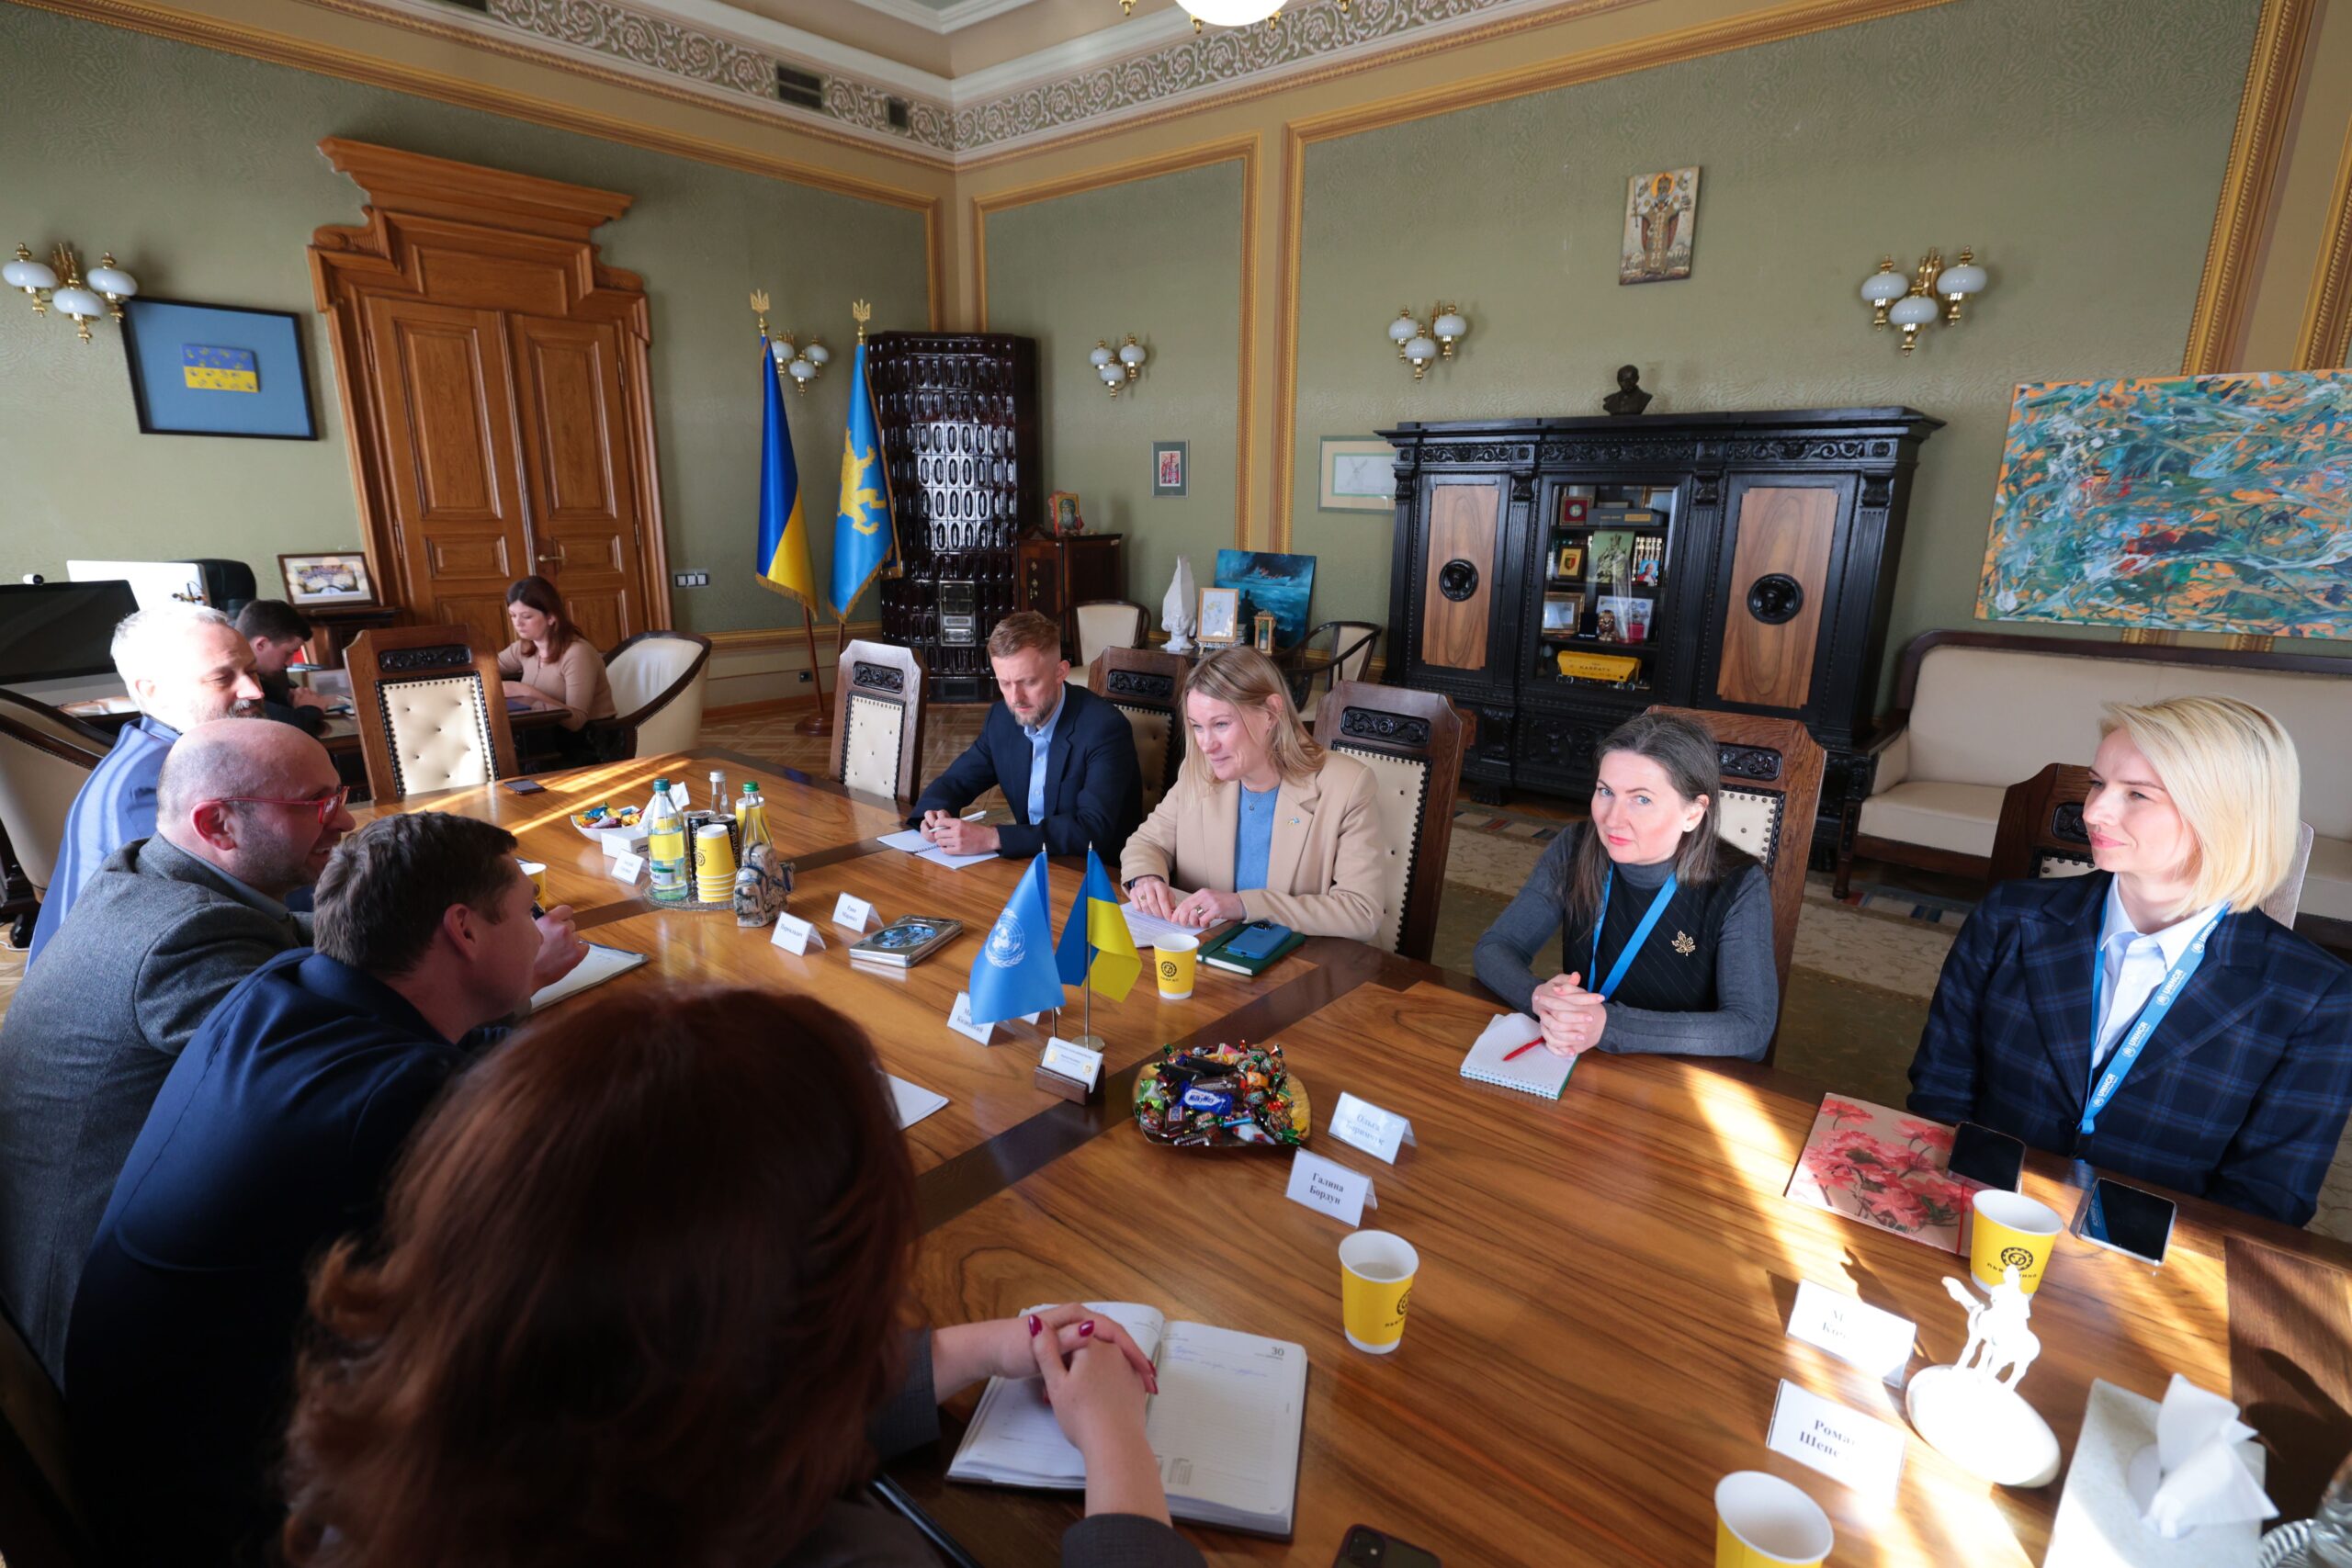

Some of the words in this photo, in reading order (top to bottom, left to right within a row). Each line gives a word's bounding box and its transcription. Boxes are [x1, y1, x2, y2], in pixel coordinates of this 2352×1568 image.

[2198, 919, 2219, 942] UNHCR
[2162, 969, 2184, 995] UNHCR
[2129, 1021, 2149, 1047] UNHCR
[2097, 1072, 2116, 1098] UNHCR
[1356, 1113, 1381, 1131] Ольга
[1312, 1172, 1344, 1192] Галина
[1272, 1347, 1284, 1357] 30
[1814, 1419, 1856, 1447] Рома
